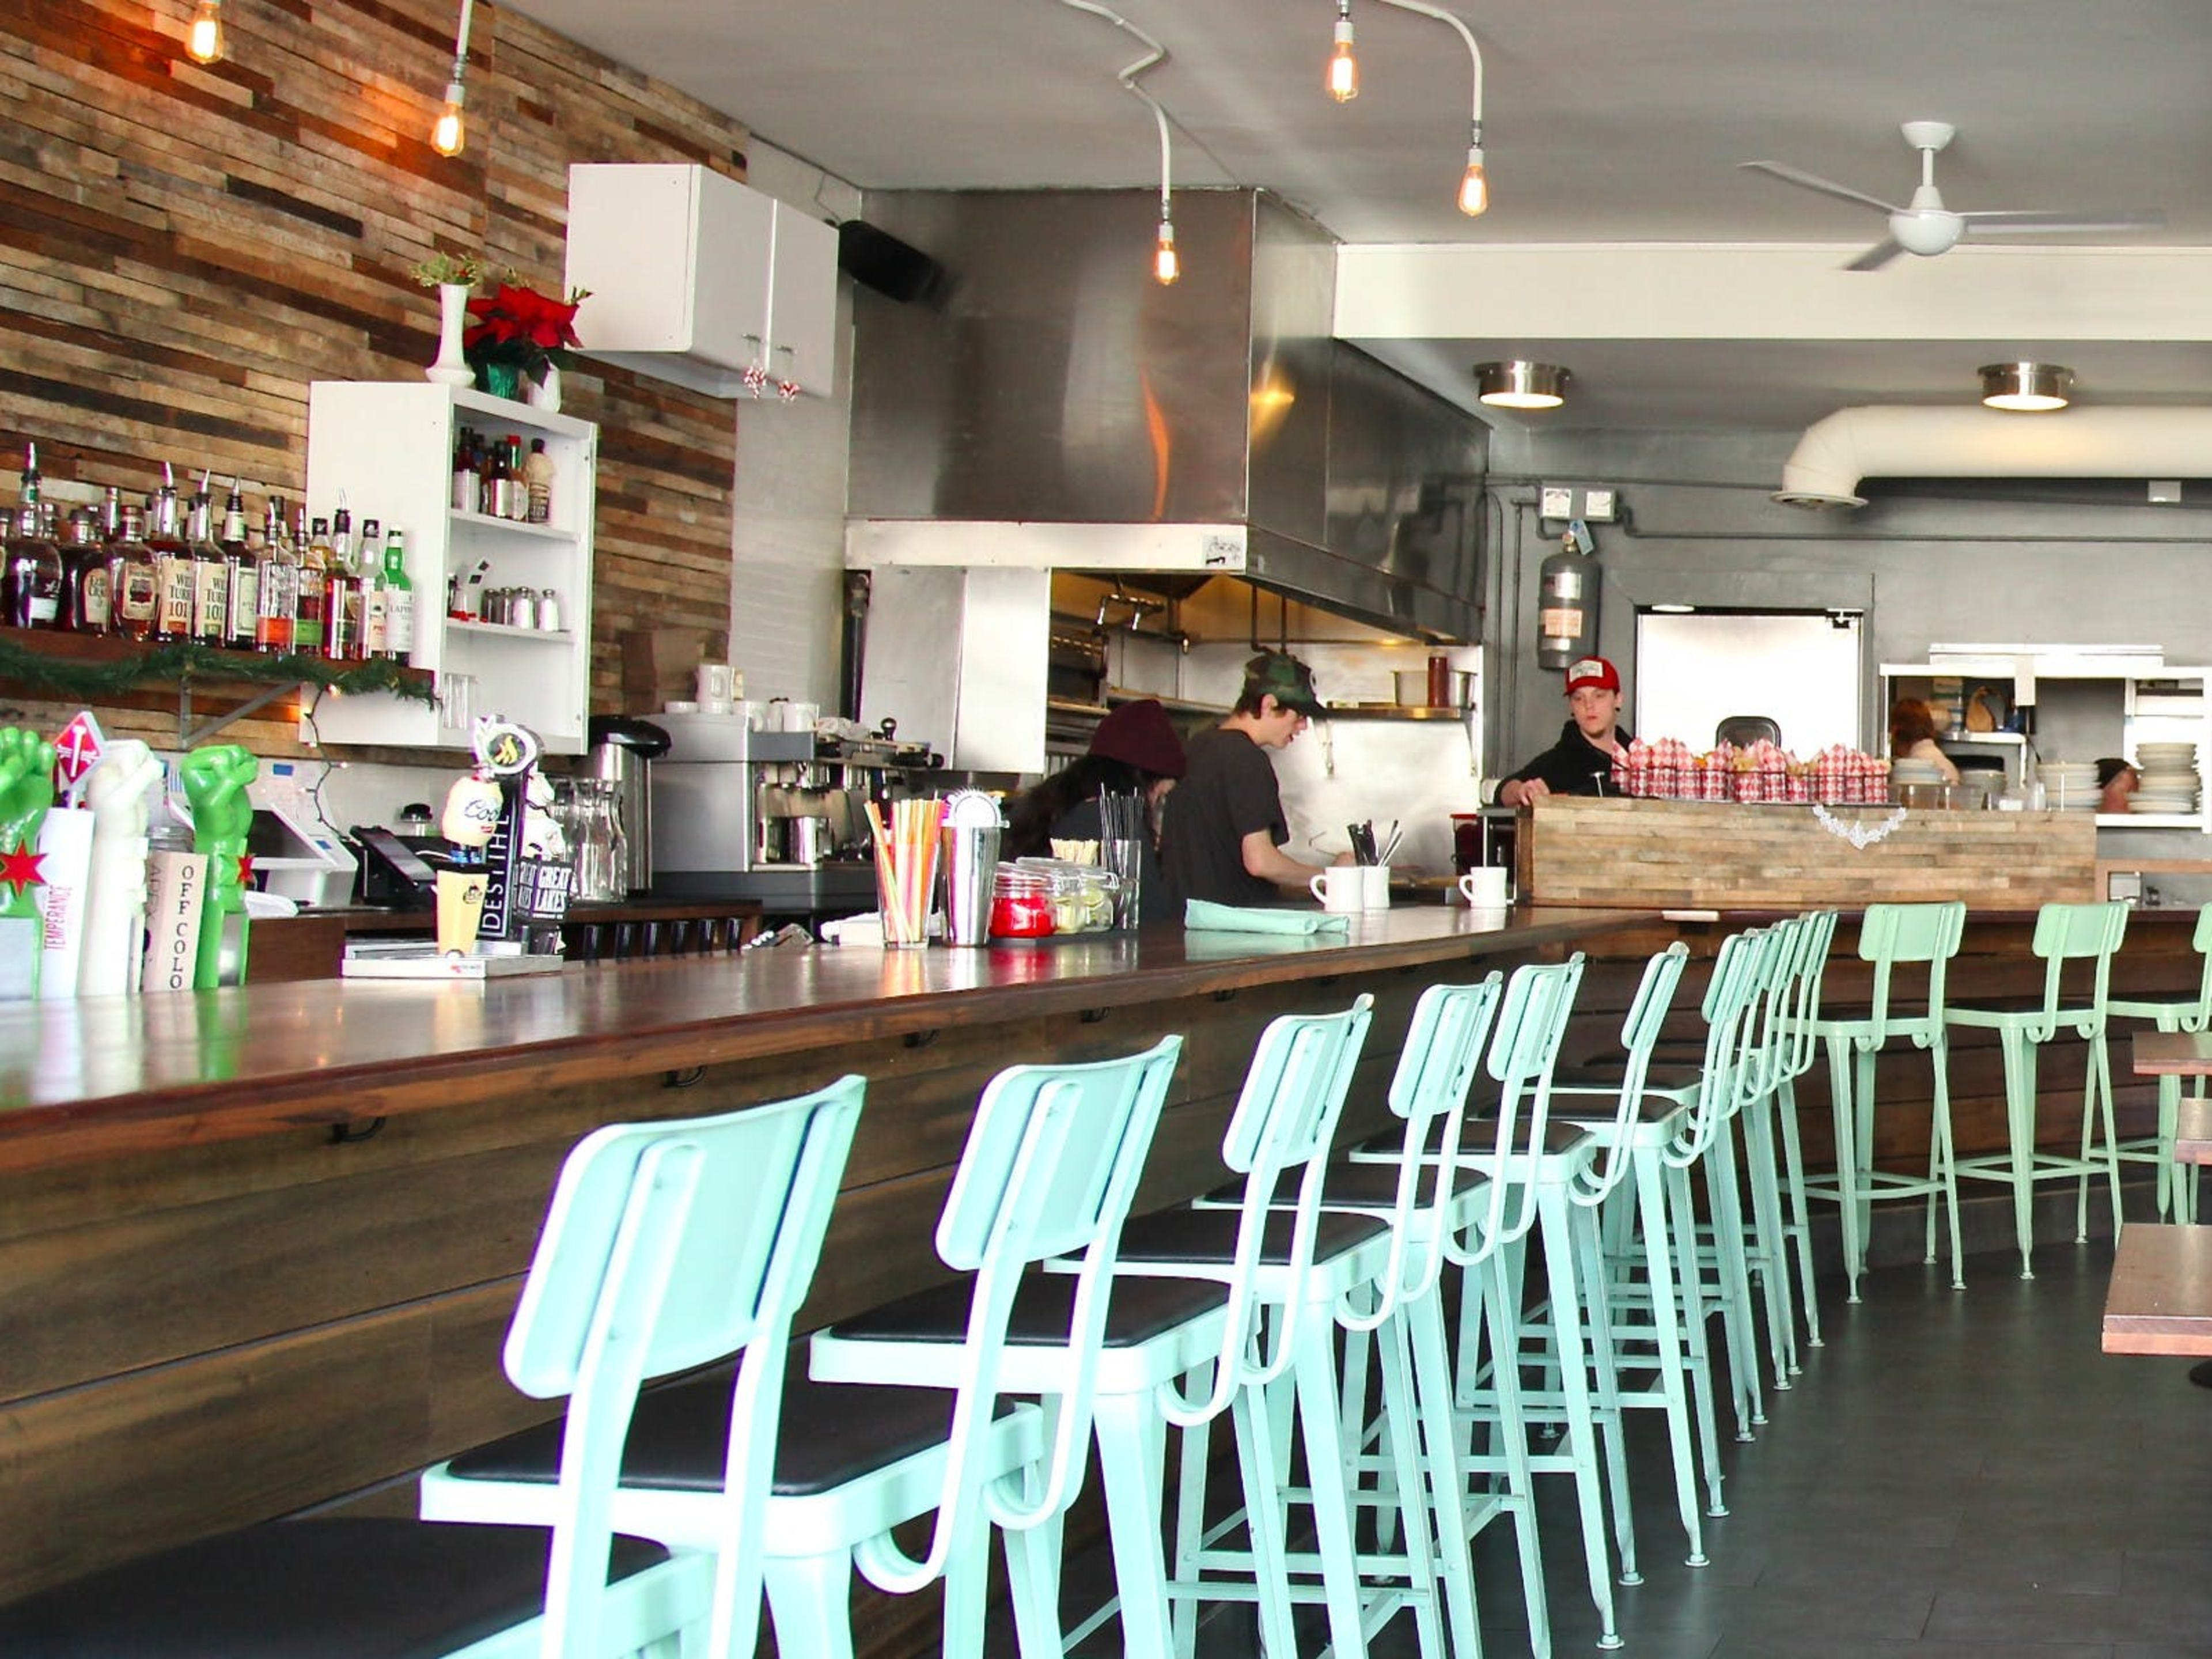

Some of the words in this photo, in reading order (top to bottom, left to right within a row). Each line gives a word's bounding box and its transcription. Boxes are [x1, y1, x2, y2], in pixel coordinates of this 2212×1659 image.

[168, 601, 187, 618] 101
[204, 604, 223, 622] 101
[179, 865, 194, 915] OFF
[539, 866, 573, 890] GREAT
[535, 889, 567, 913] LAKES
[44, 885, 72, 950] TEMPERANCE
[169, 922, 188, 989] COLO
